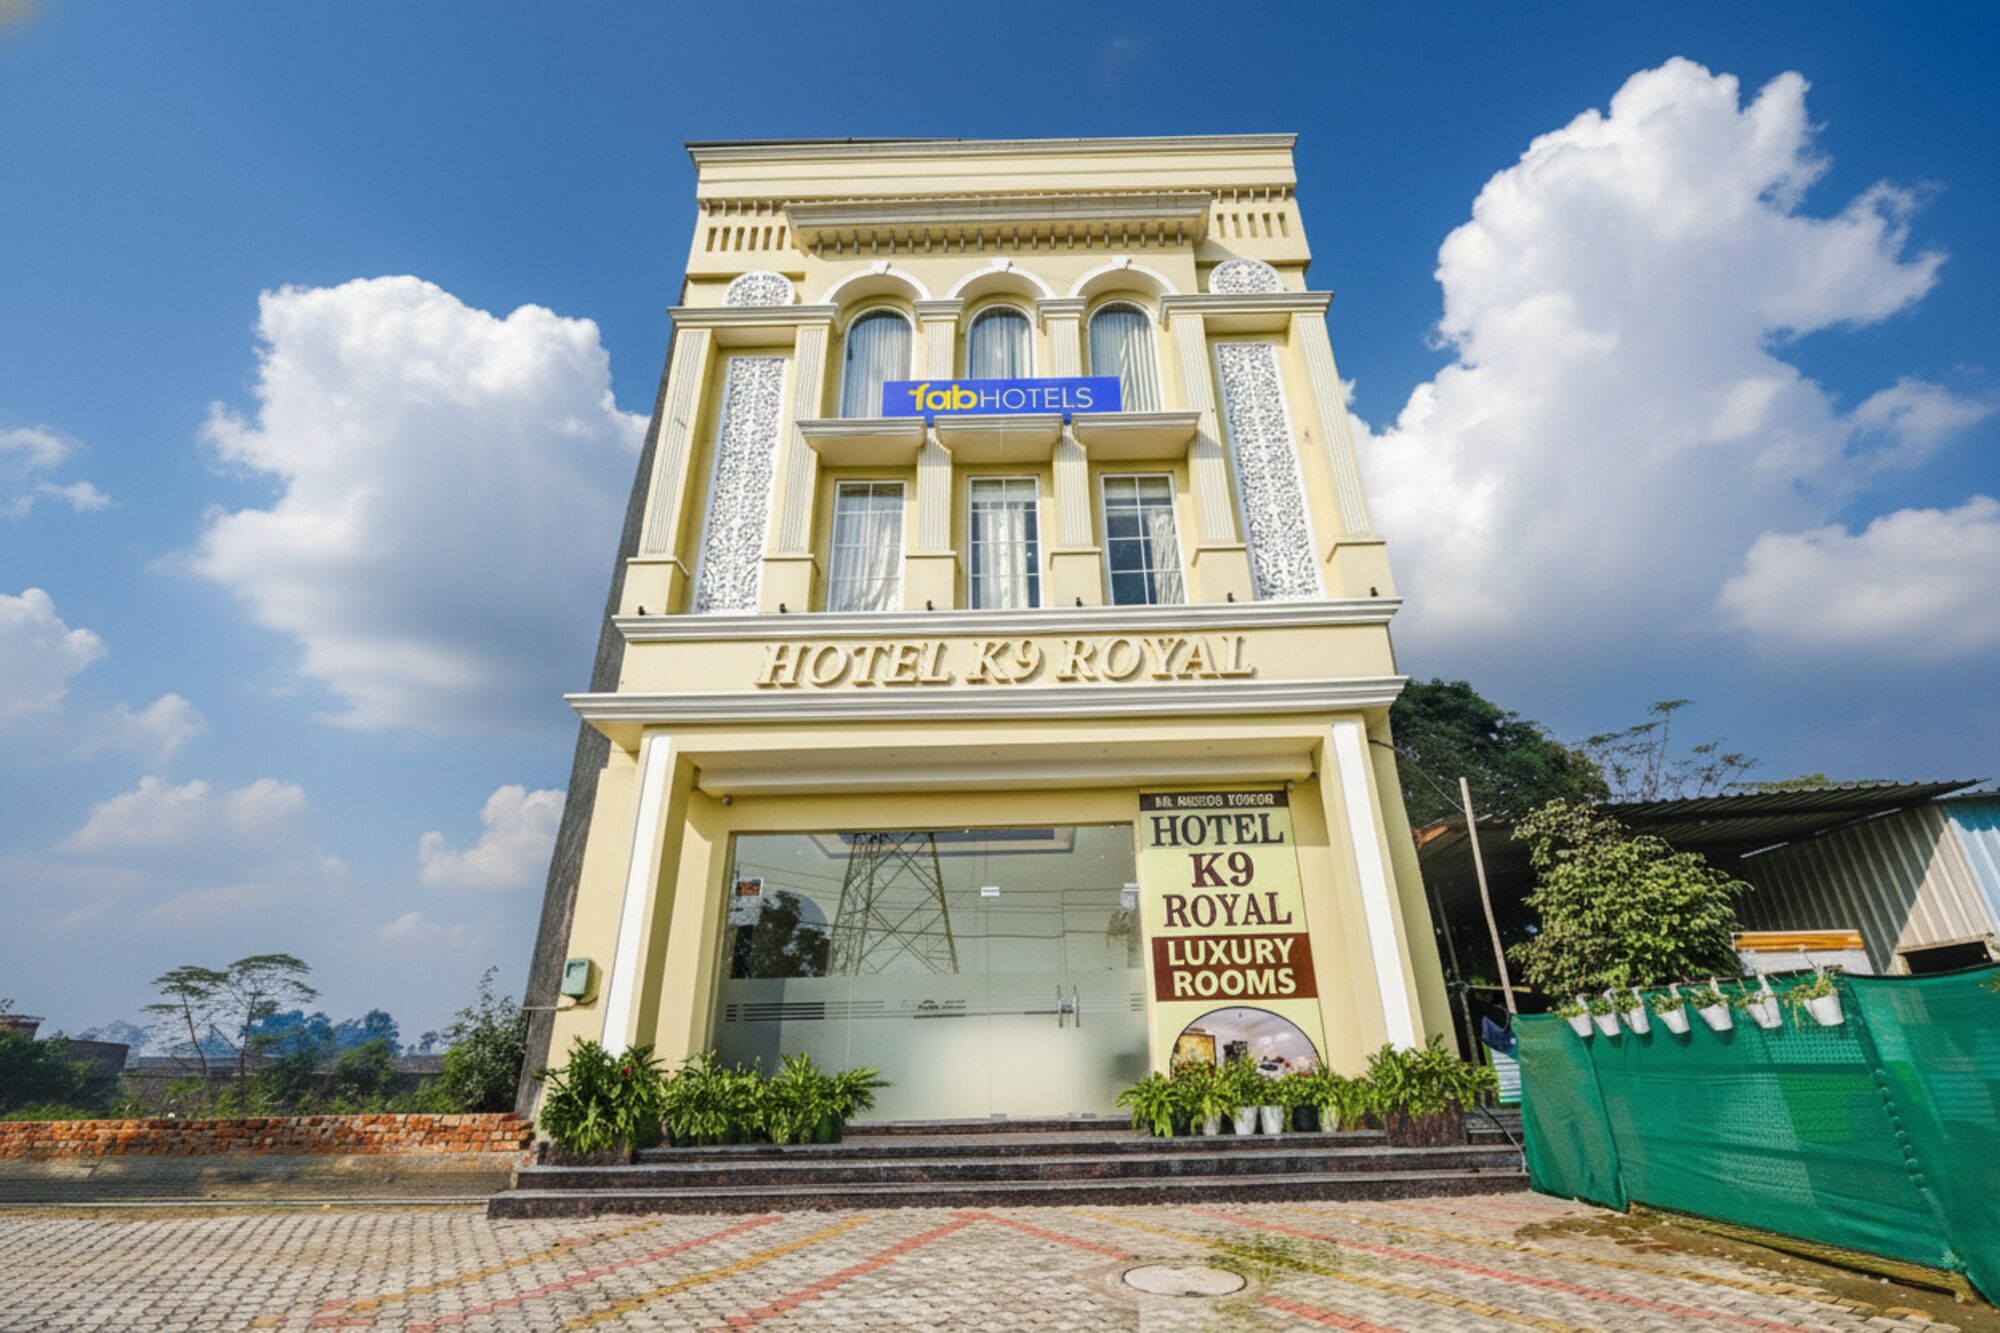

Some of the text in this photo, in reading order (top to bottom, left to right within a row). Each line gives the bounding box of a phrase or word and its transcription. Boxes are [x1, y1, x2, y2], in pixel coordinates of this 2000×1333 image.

[755, 635, 1256, 688] HOTEL K9 ROYAL
[1150, 813, 1284, 846] HOTEL
[1189, 851, 1254, 888] K9
[1162, 892, 1292, 927] ROYAL
[1167, 938, 1294, 966] LUXURY
[1173, 967, 1297, 997] ROOMS
